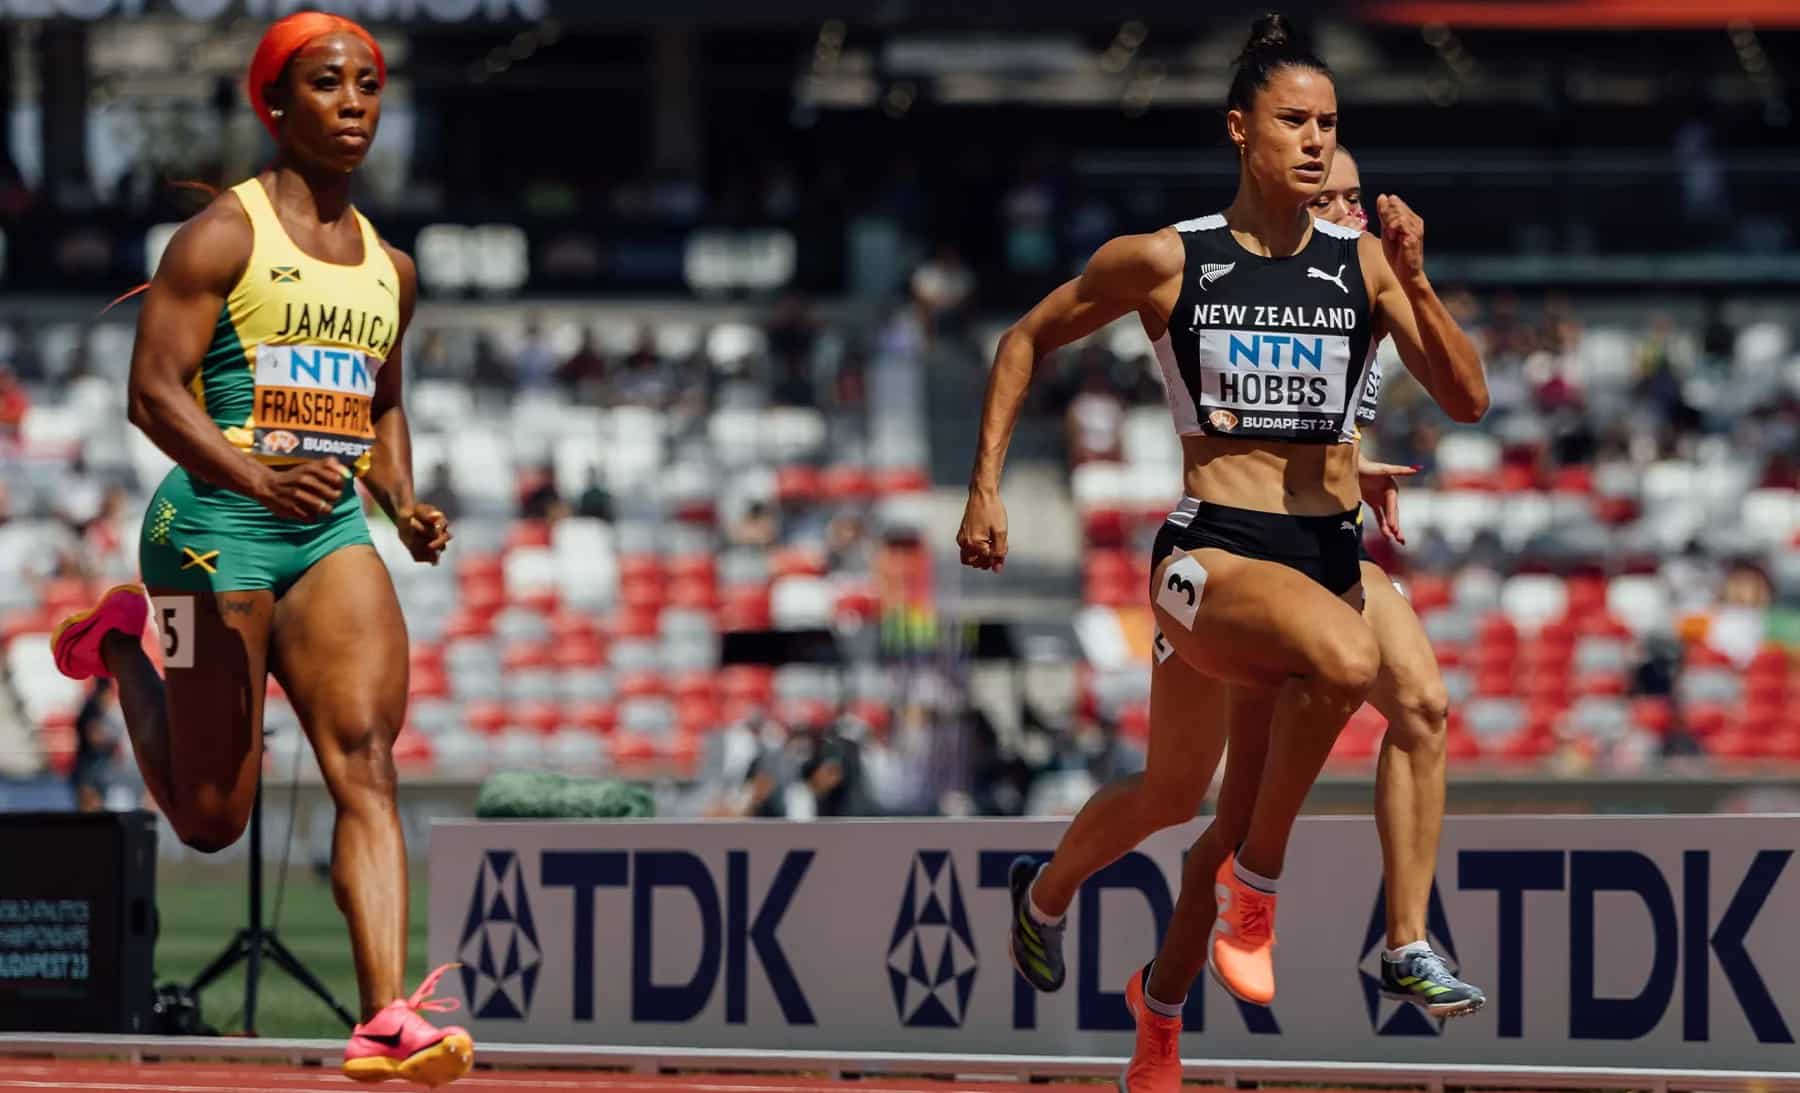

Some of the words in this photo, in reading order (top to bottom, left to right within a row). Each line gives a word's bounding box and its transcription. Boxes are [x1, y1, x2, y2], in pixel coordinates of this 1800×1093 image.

[1193, 304, 1247, 326] NEW
[1254, 306, 1356, 329] ZEALAND
[1229, 334, 1323, 371] NTN
[1219, 372, 1327, 407] HOBBS
[1242, 416, 1317, 430] BUDAPEST
[1319, 419, 1335, 430] 23
[1167, 572, 1195, 607] 3
[161, 608, 178, 657] 5
[540, 850, 817, 1027] TDK
[1457, 850, 1796, 1044] TDK
